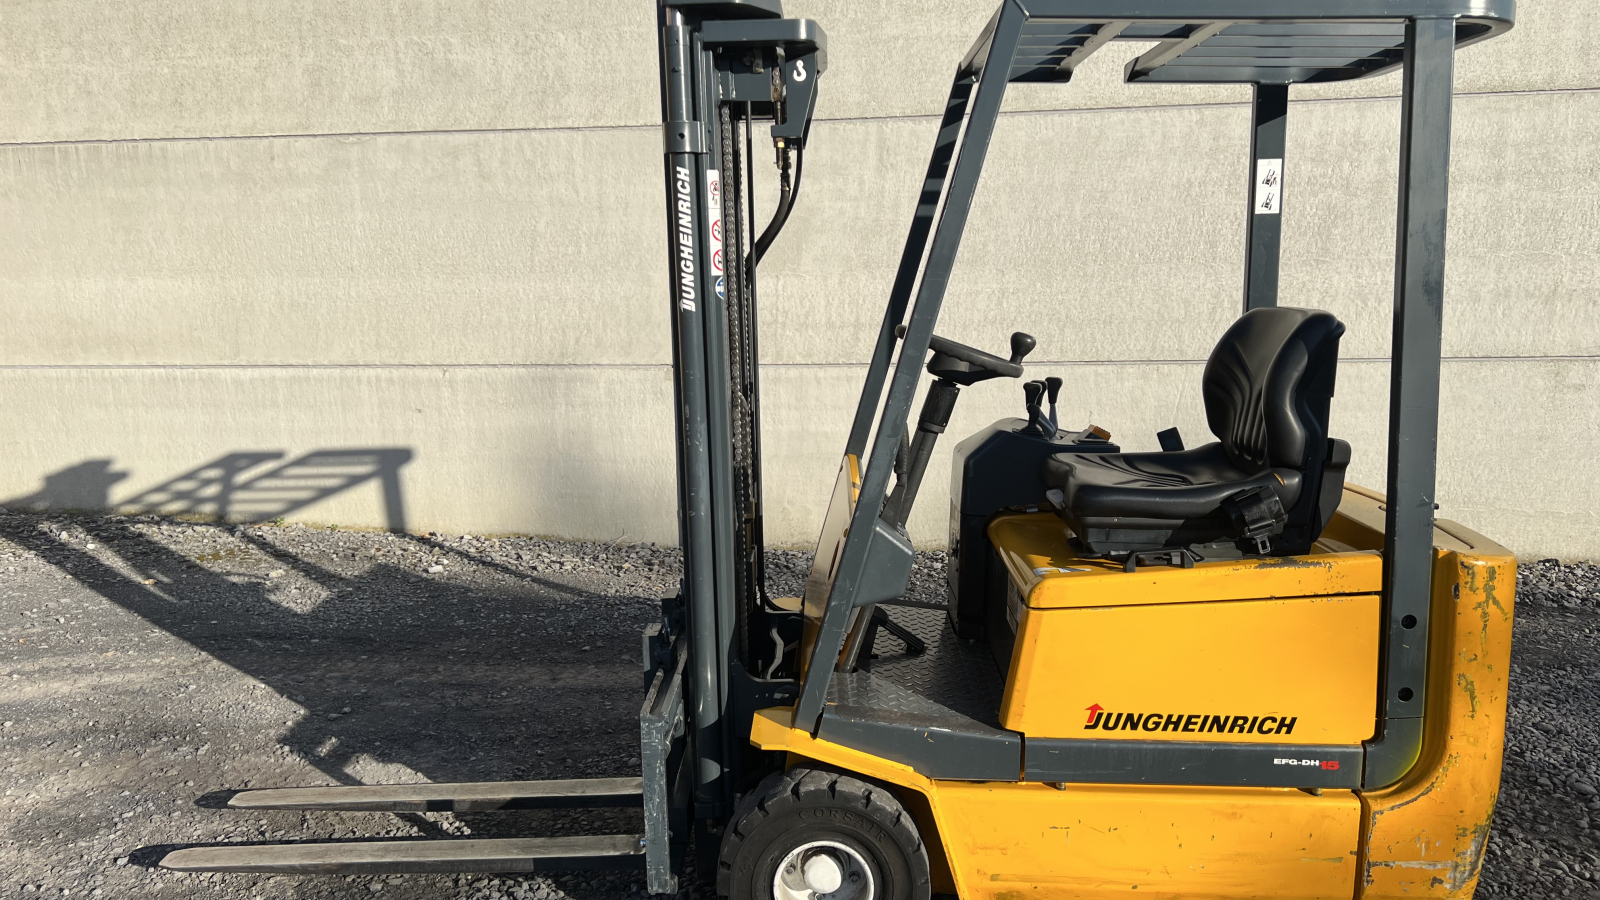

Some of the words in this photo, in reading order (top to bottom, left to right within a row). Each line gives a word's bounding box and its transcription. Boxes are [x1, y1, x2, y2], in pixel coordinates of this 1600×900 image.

[677, 166, 696, 312] JUNGHEINRICH
[1084, 711, 1298, 735] JUNGHEINRICH
[798, 808, 888, 843] CORSAIR
